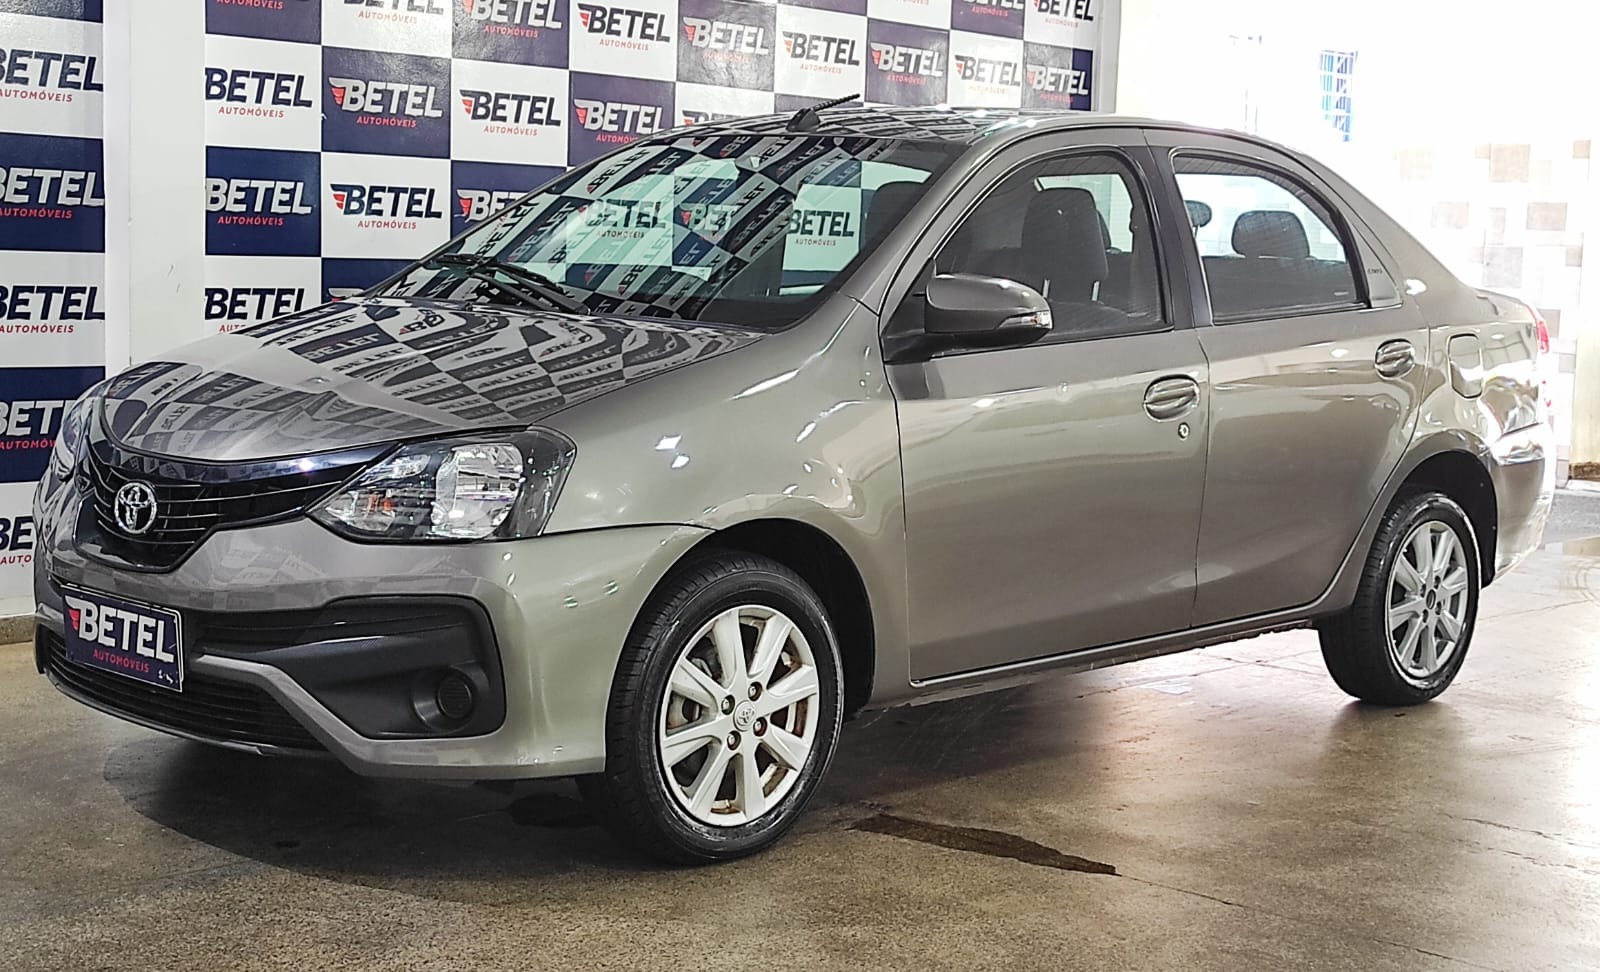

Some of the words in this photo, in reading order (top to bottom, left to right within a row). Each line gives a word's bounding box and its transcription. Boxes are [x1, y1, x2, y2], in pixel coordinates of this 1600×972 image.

[358, 11, 417, 24] AUTOMÓVEIS
[471, 0, 562, 29] BETEL
[578, 3, 670, 42] BETEL
[600, 39, 649, 50] AUTOMÓVEIS
[683, 17, 769, 55] BETEL
[782, 31, 859, 66] BETEL
[871, 43, 943, 77] BETEL
[954, 55, 1020, 86] BETEL
[205, 67, 312, 107] BETEL
[1027, 65, 1088, 95] BETEL
[218, 106, 285, 118] AUTOMÓVEIS
[329, 77, 442, 117] BETEL
[460, 90, 561, 126] BETEL
[357, 116, 416, 127] AUTOMÓVEIS
[484, 126, 538, 136] AUTOMÓVEIS
[574, 99, 664, 134] BETEL
[206, 177, 312, 214] BETEL
[331, 184, 442, 218] BETEL
[218, 215, 284, 225] AUTOMÓVEIS
[358, 220, 416, 229] AUTOMÓVEIS
[788, 210, 854, 237] BETEL
[65, 595, 174, 663] BETEL
